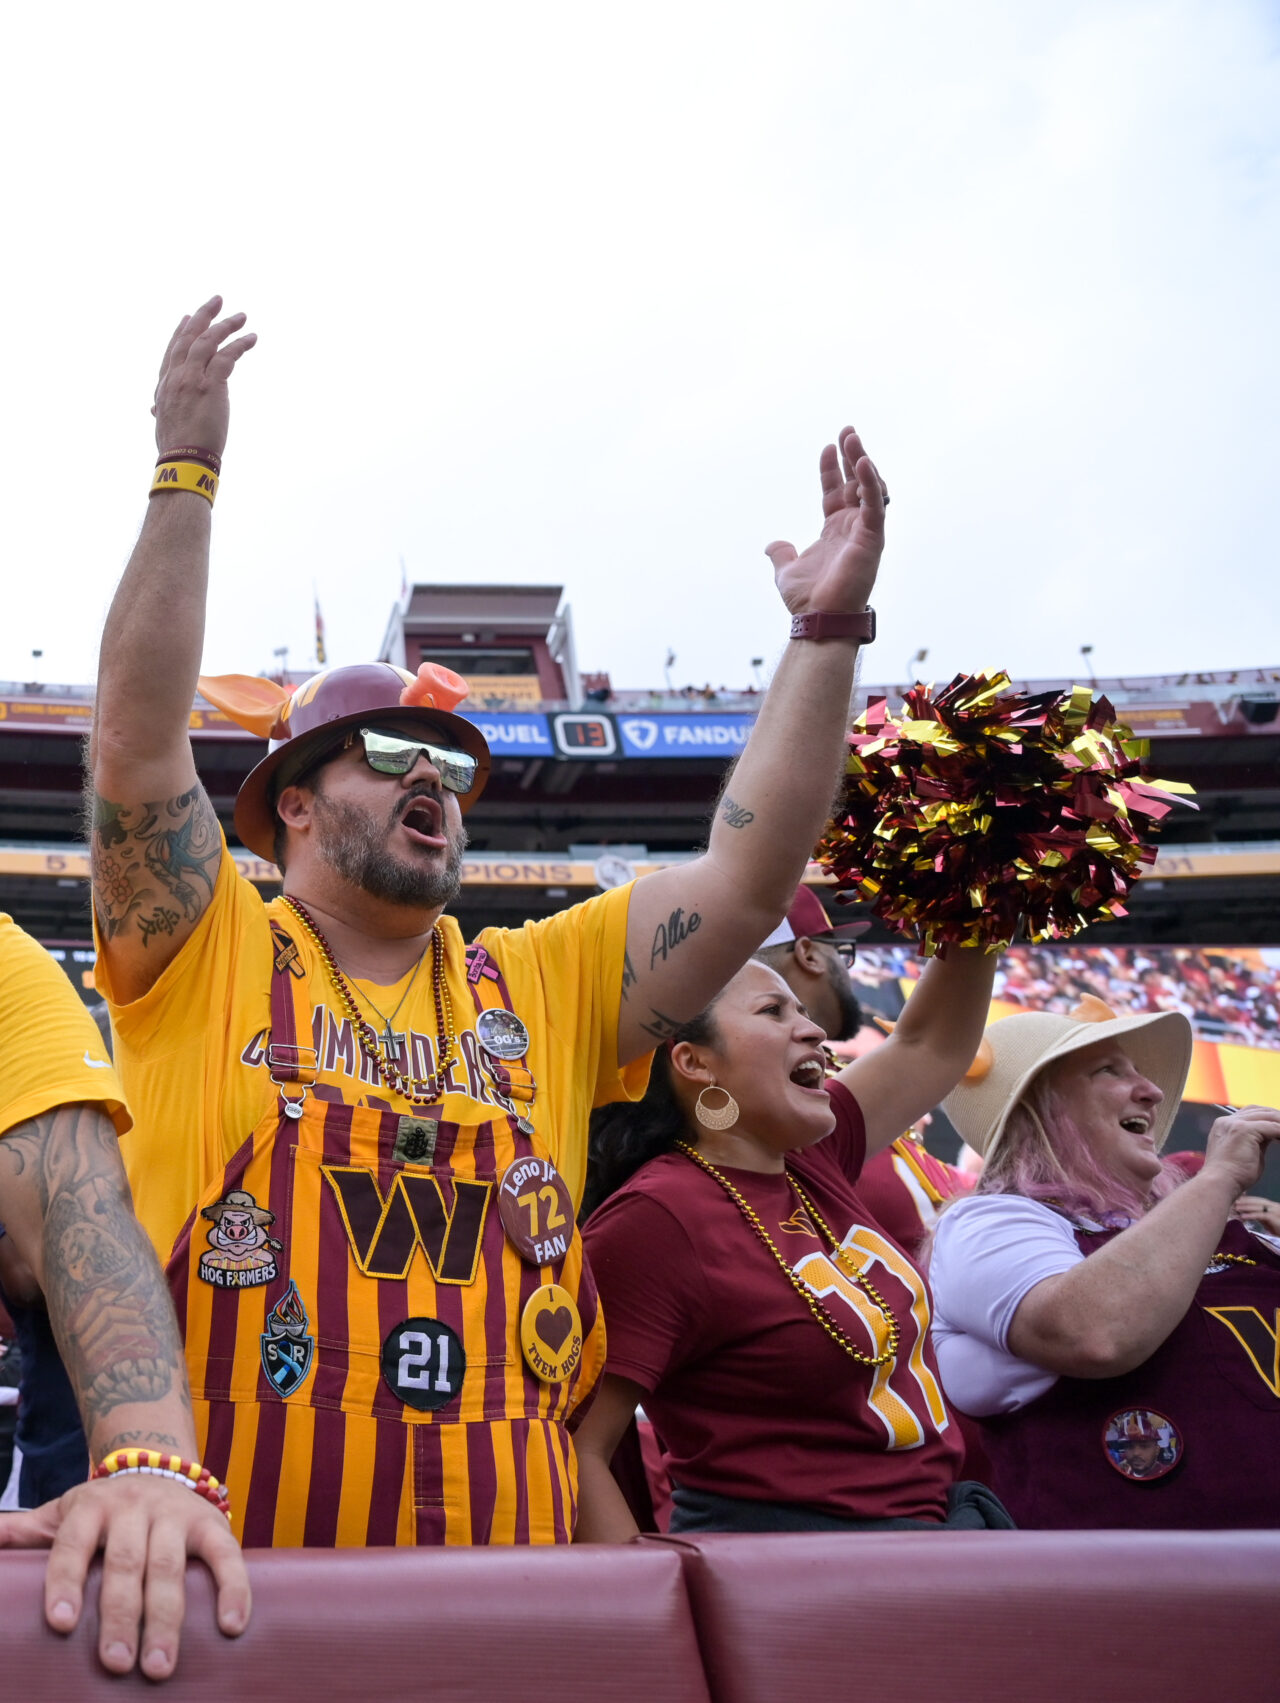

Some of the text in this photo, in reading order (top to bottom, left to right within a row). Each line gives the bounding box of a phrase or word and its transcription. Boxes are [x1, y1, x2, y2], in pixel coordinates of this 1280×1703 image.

[478, 723, 549, 744] DUEL
[574, 721, 606, 747] 13
[650, 907, 702, 971] Allie
[503, 1160, 557, 1197] Leno Jr
[319, 1165, 496, 1287] W
[517, 1185, 567, 1238] 72
[533, 1233, 567, 1264] FAN
[201, 1263, 224, 1286] HOG
[547, 1287, 554, 1303] I
[267, 1343, 305, 1363] S R
[397, 1330, 452, 1393] 21
[527, 1334, 583, 1380] THEM HOGS
